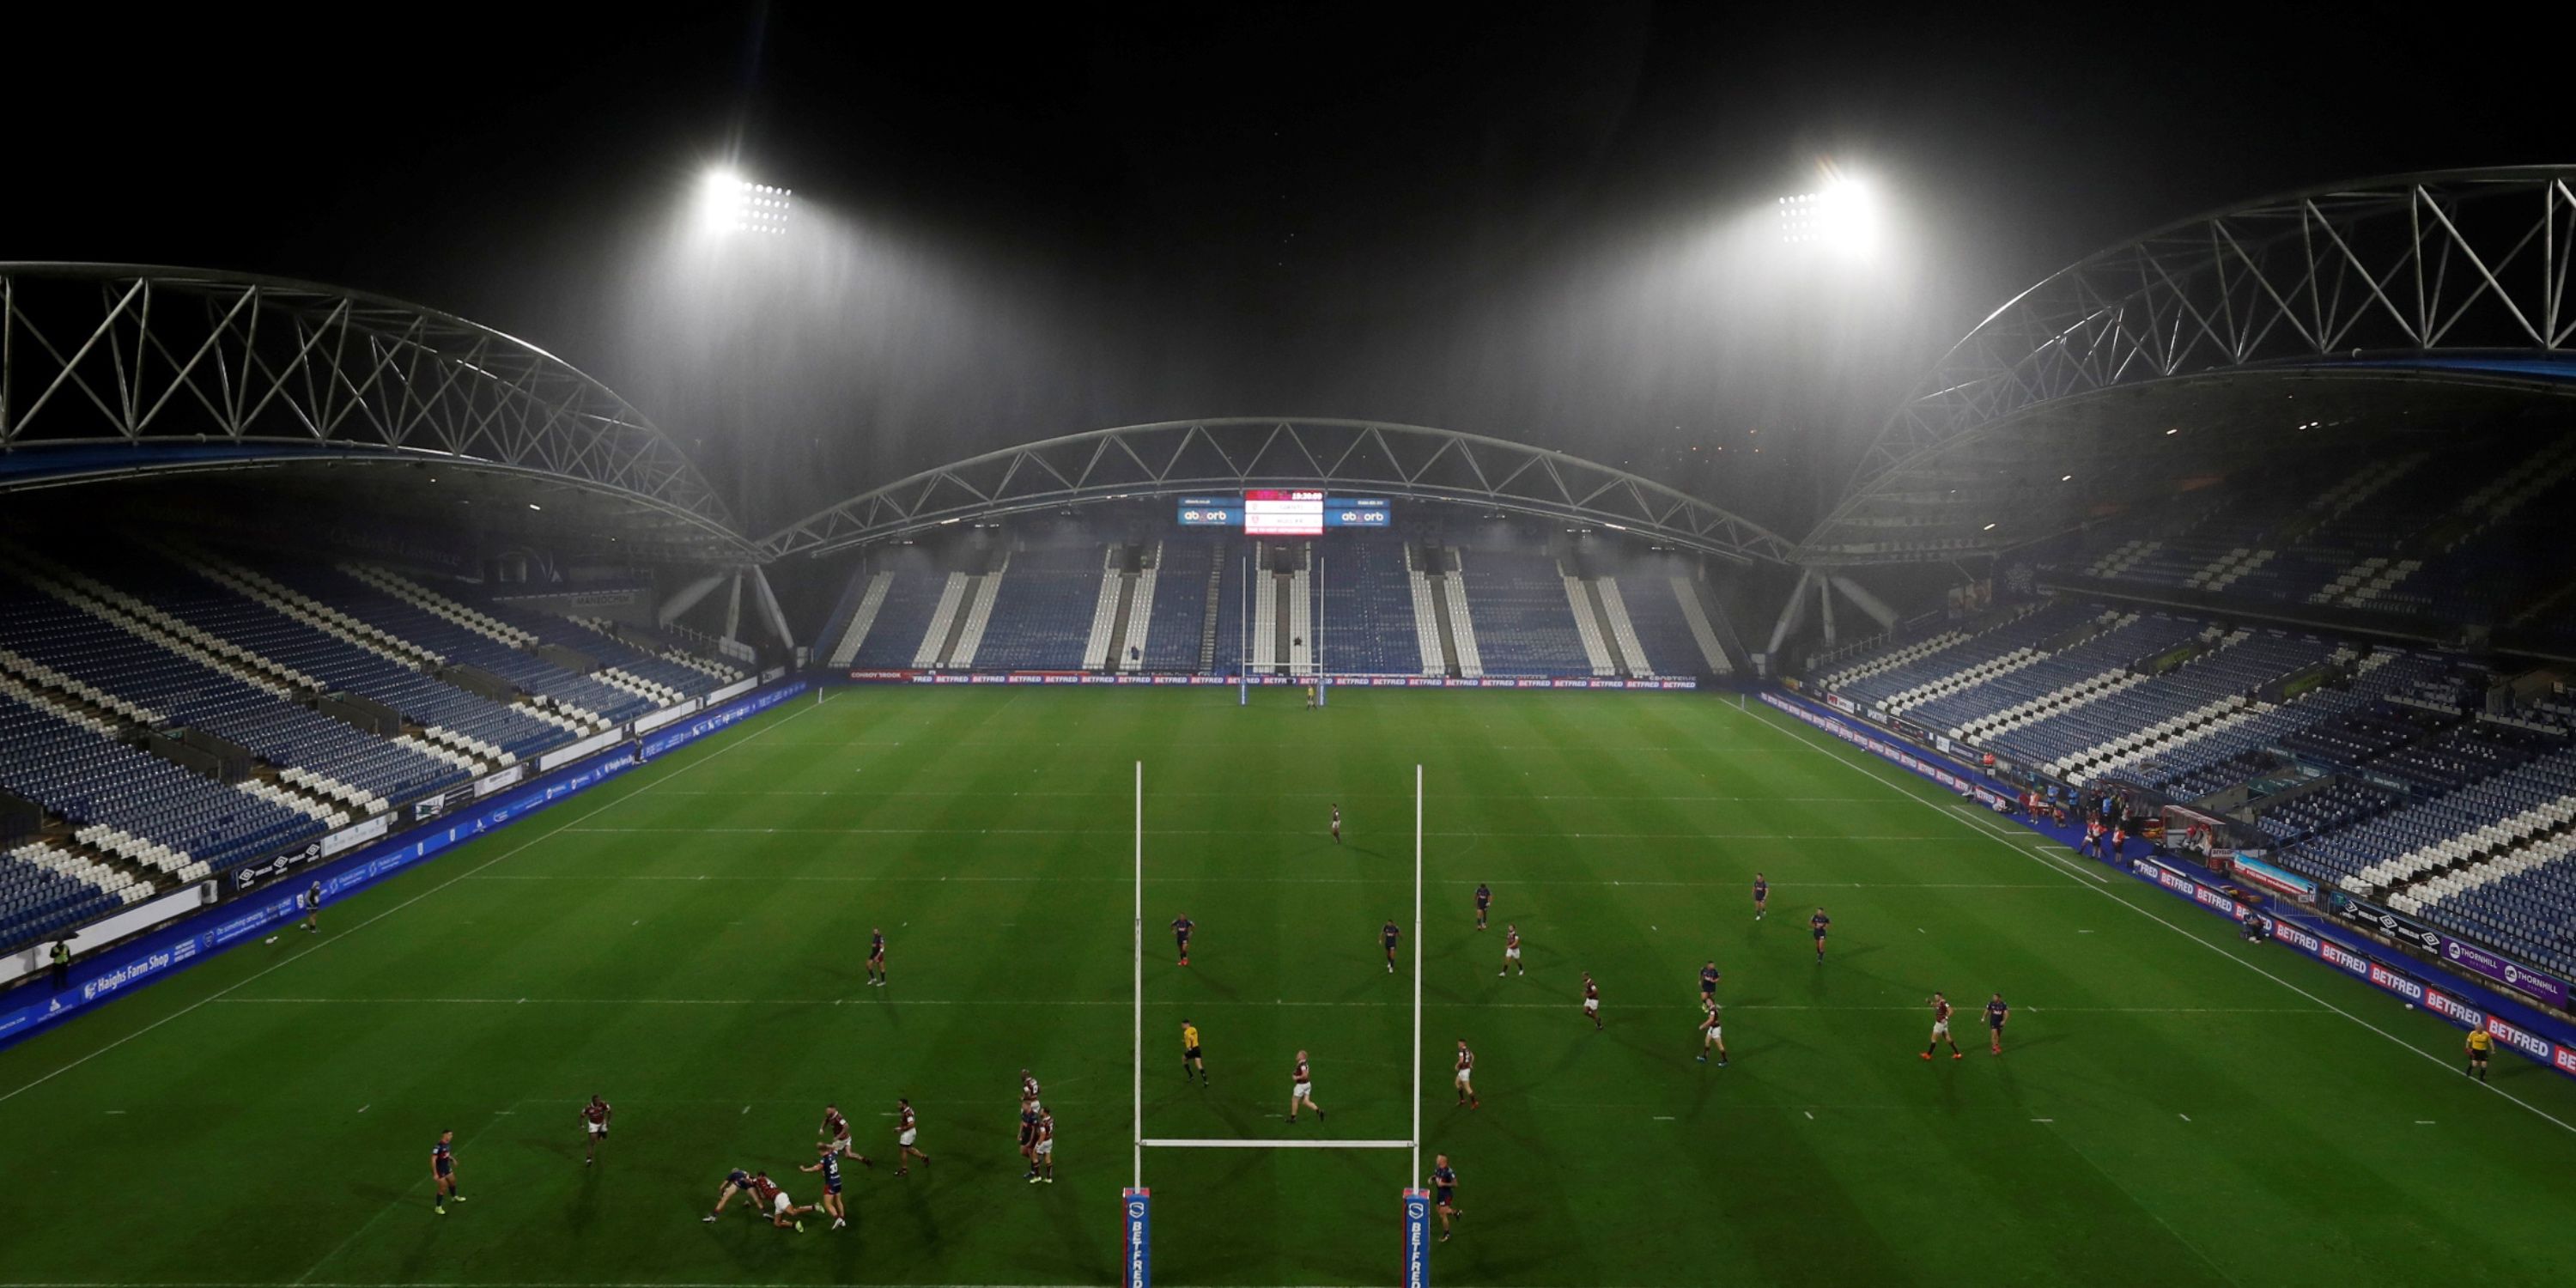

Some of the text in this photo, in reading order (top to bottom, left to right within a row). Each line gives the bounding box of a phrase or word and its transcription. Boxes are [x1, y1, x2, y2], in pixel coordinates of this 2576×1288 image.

[98, 953, 169, 992] Haighs Farm Shop
[2161, 872, 2193, 894] BETFRED
[2197, 889, 2232, 912] BETFRED
[2277, 923, 2318, 951] BETFRED
[2323, 945, 2366, 974] BETFRED
[2372, 968, 2421, 998] BETFRED
[2427, 992, 2482, 1026] BETFRED
[2489, 1019, 2549, 1057] BETFRED
[2460, 948, 2498, 969] THORNHILL
[2518, 971, 2558, 995] THORNHILL
[1132, 1221, 1142, 1288] BETFRED
[1411, 1222, 1422, 1288] BETFRED
